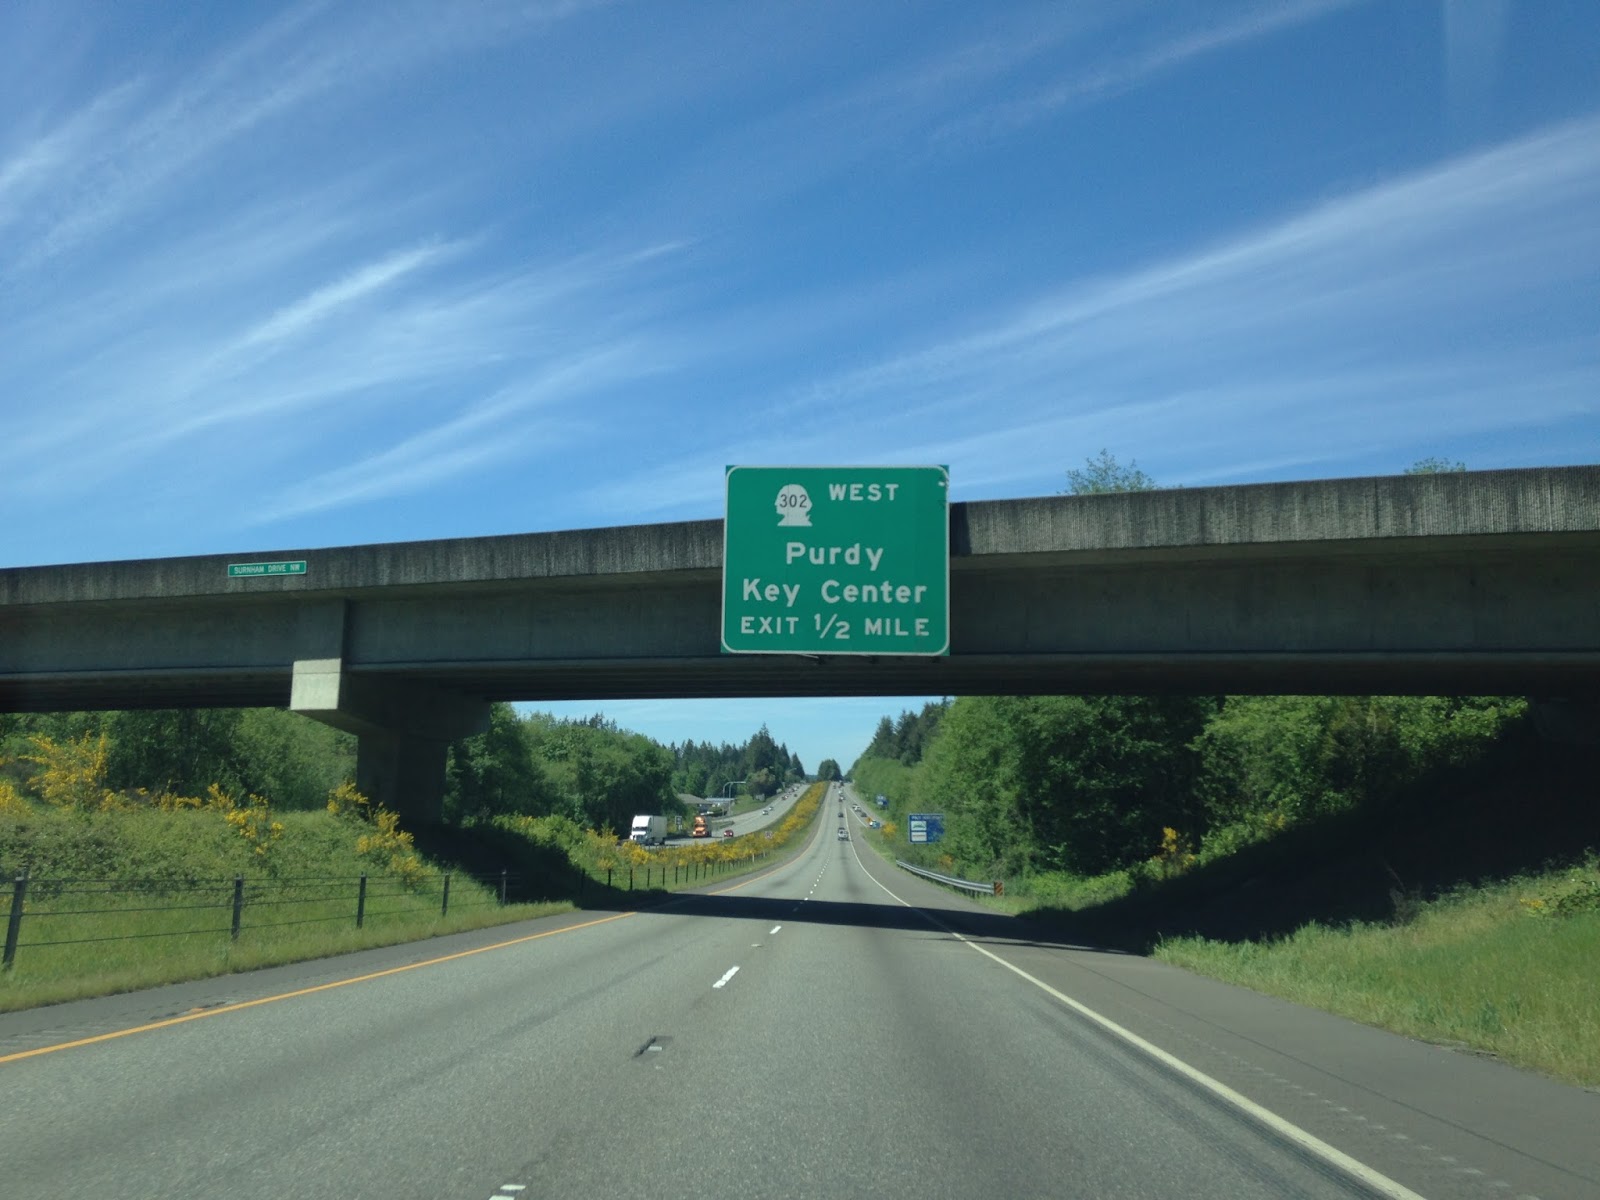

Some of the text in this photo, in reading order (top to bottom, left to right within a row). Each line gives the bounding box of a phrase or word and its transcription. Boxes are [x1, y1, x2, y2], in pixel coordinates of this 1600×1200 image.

[779, 494, 808, 508] 302
[829, 484, 899, 501] WEST
[786, 542, 883, 571] Purdy
[268, 564, 287, 573] DRIVE
[742, 578, 927, 607] Key Center
[741, 613, 929, 640] EXIT 1/2 MILE
